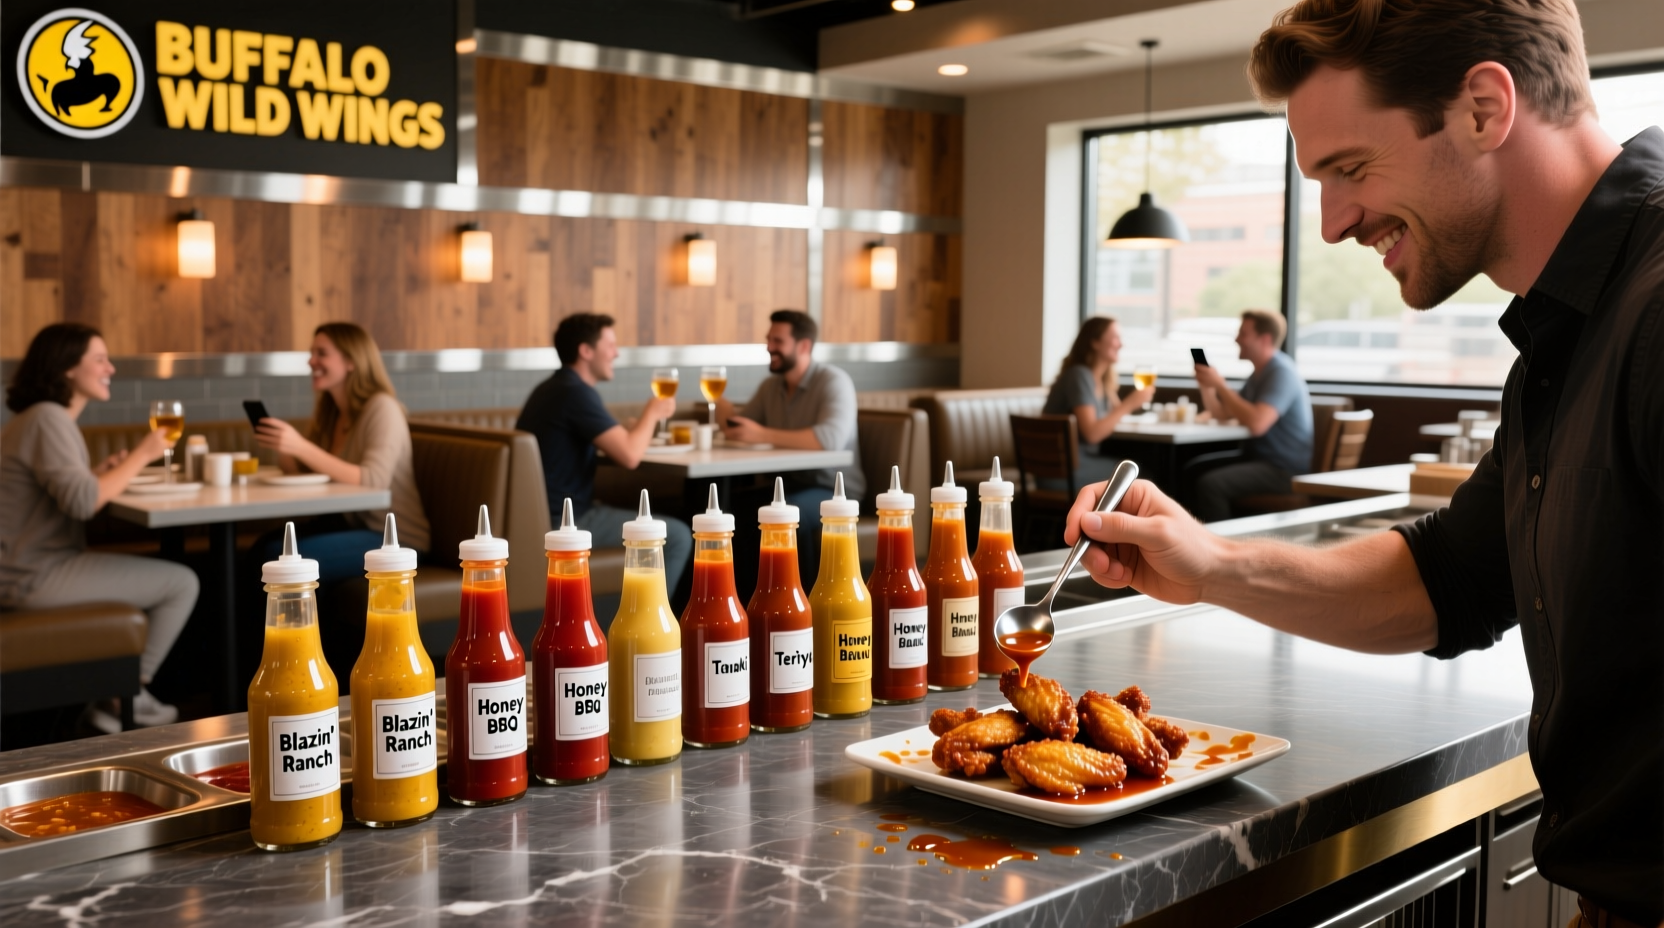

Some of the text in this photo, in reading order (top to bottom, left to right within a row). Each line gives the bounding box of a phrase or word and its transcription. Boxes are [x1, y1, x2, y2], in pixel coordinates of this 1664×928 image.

[155, 20, 391, 97] BUFFALO
[157, 76, 446, 151] WILD WINGS
[564, 681, 608, 698] Honey
[478, 696, 524, 716] Honey
[382, 708, 433, 733] Blazin'
[279, 725, 335, 752] Blazin'
[385, 730, 432, 753] Ranch
[282, 750, 333, 773] Ranch
